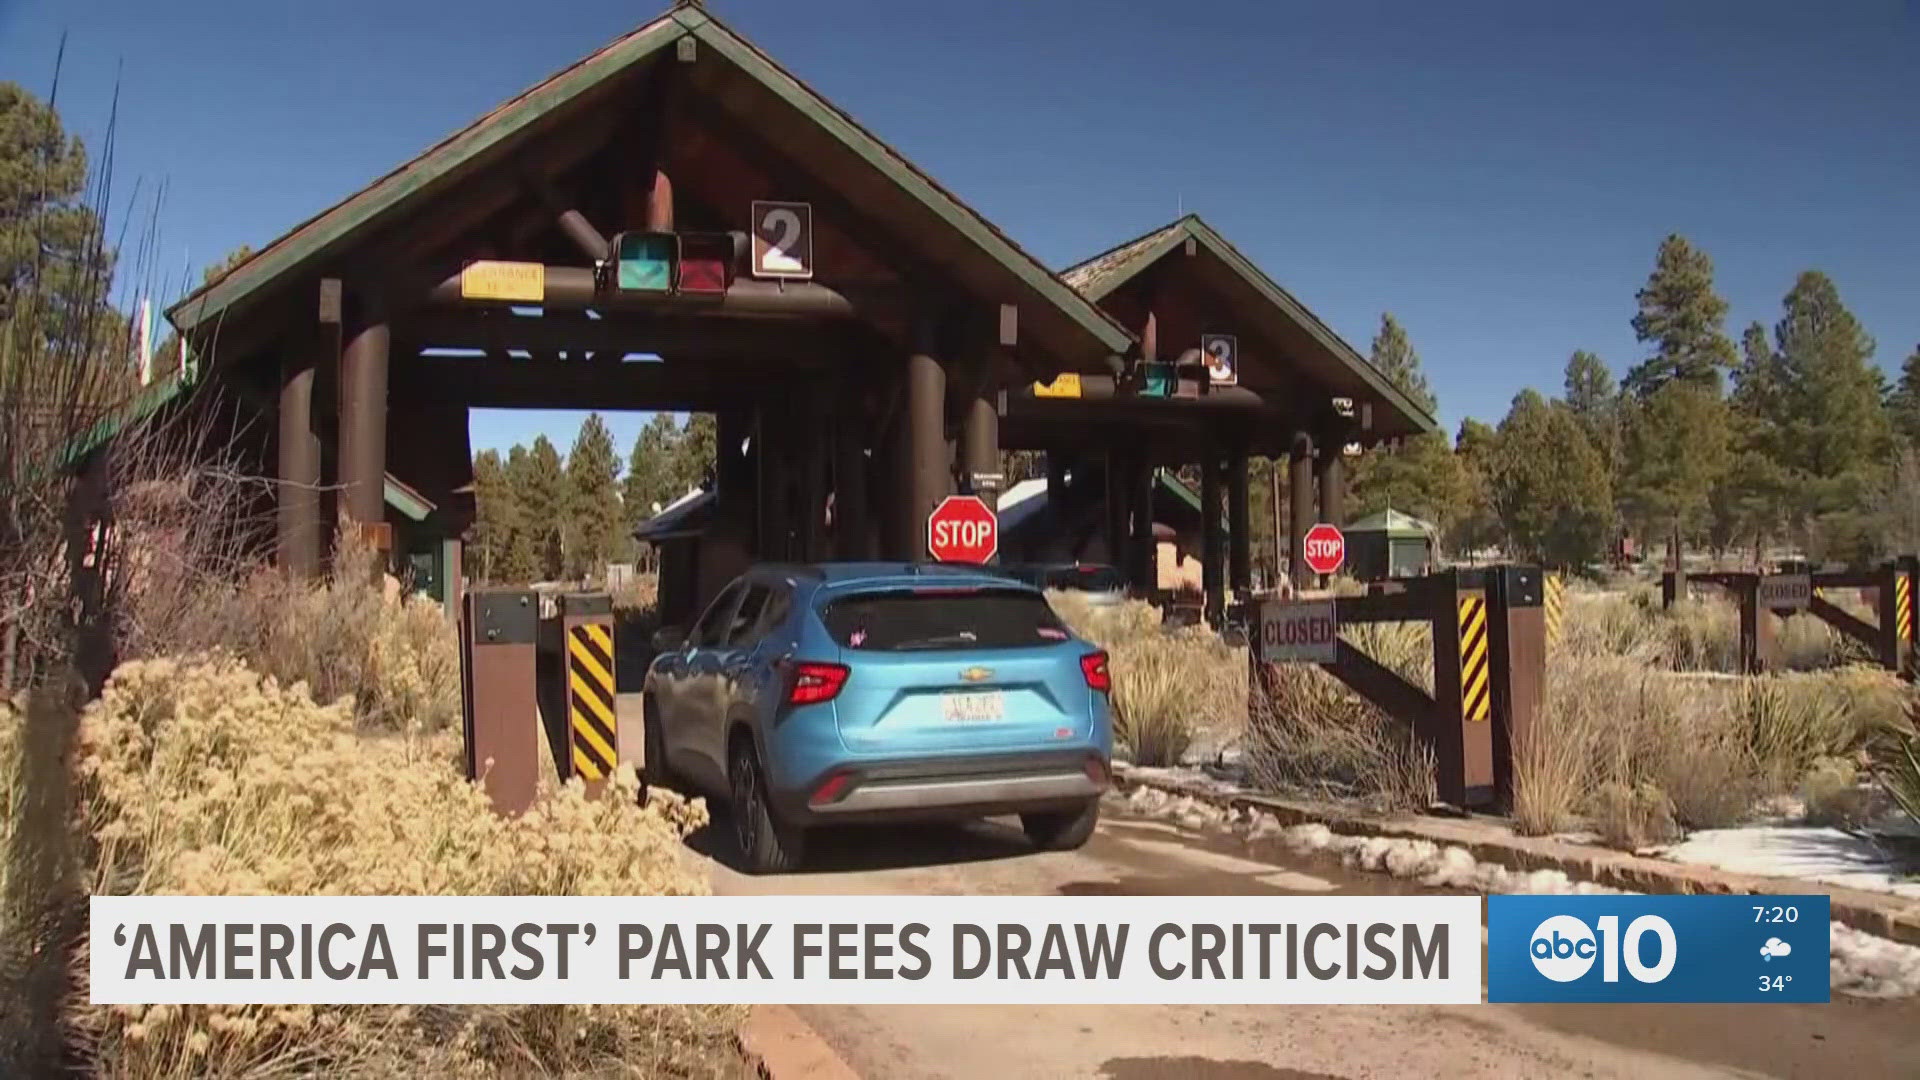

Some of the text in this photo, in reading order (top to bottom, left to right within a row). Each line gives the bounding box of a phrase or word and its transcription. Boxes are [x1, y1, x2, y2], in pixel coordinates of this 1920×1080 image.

[762, 208, 802, 271] 2
[1209, 340, 1231, 380] 3
[935, 520, 992, 548] STOP
[1307, 539, 1341, 557] STOP
[1761, 583, 1808, 601] CLOSED
[1264, 617, 1332, 646] CLOSED
